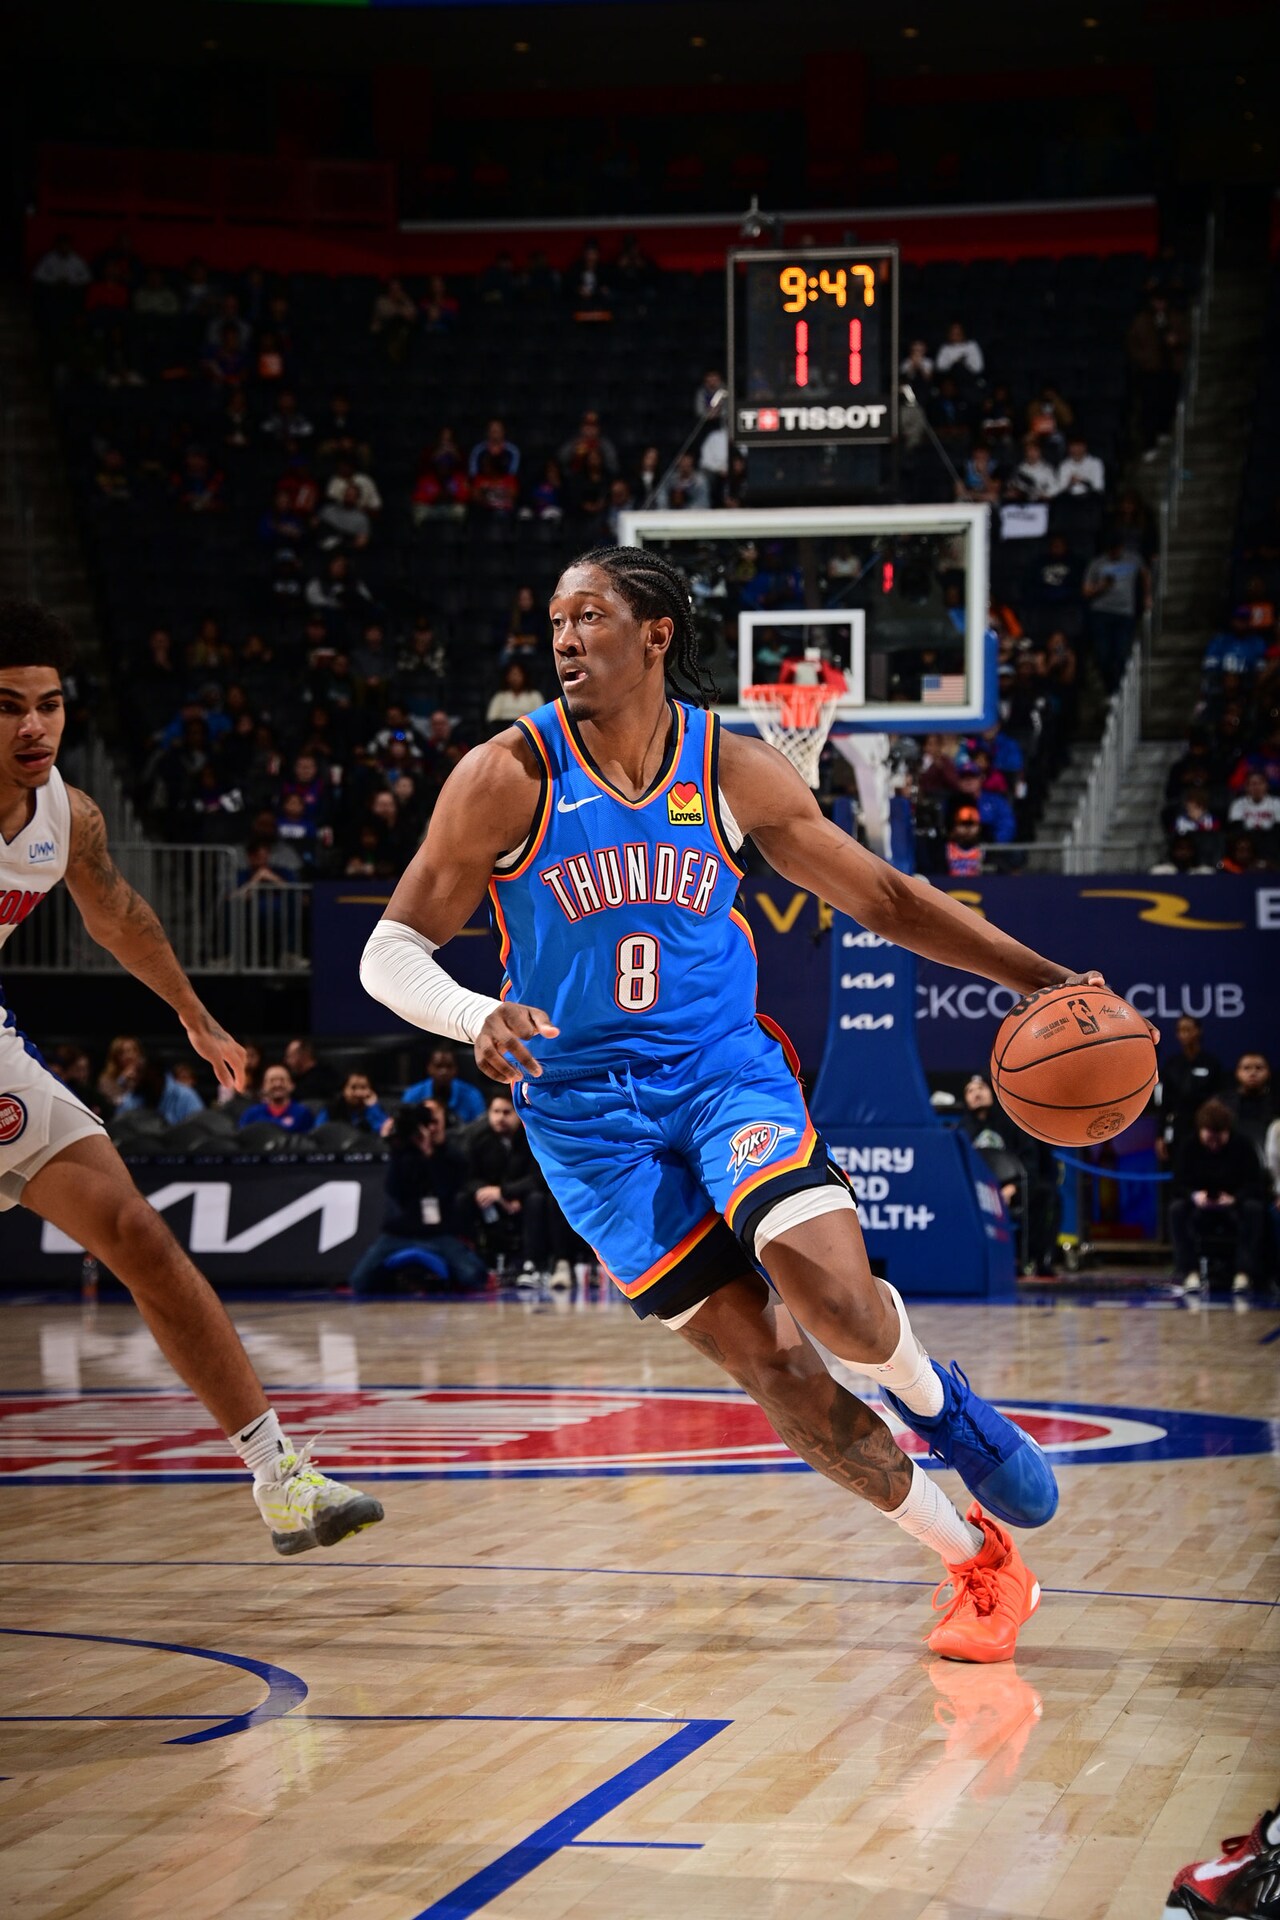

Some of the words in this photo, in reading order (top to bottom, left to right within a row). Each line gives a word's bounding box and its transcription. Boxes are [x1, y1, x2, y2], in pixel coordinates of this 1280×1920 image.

[780, 265, 875, 313] 9:47
[781, 405, 887, 430] TISSOT
[30, 842, 55, 858] UWM
[540, 843, 719, 923] THUNDER
[615, 933, 660, 1012] 8
[1123, 984, 1246, 1019] CLUB
[737, 1128, 767, 1168] OKC
[831, 1146, 915, 1173] ENRY
[850, 1175, 890, 1201] RD
